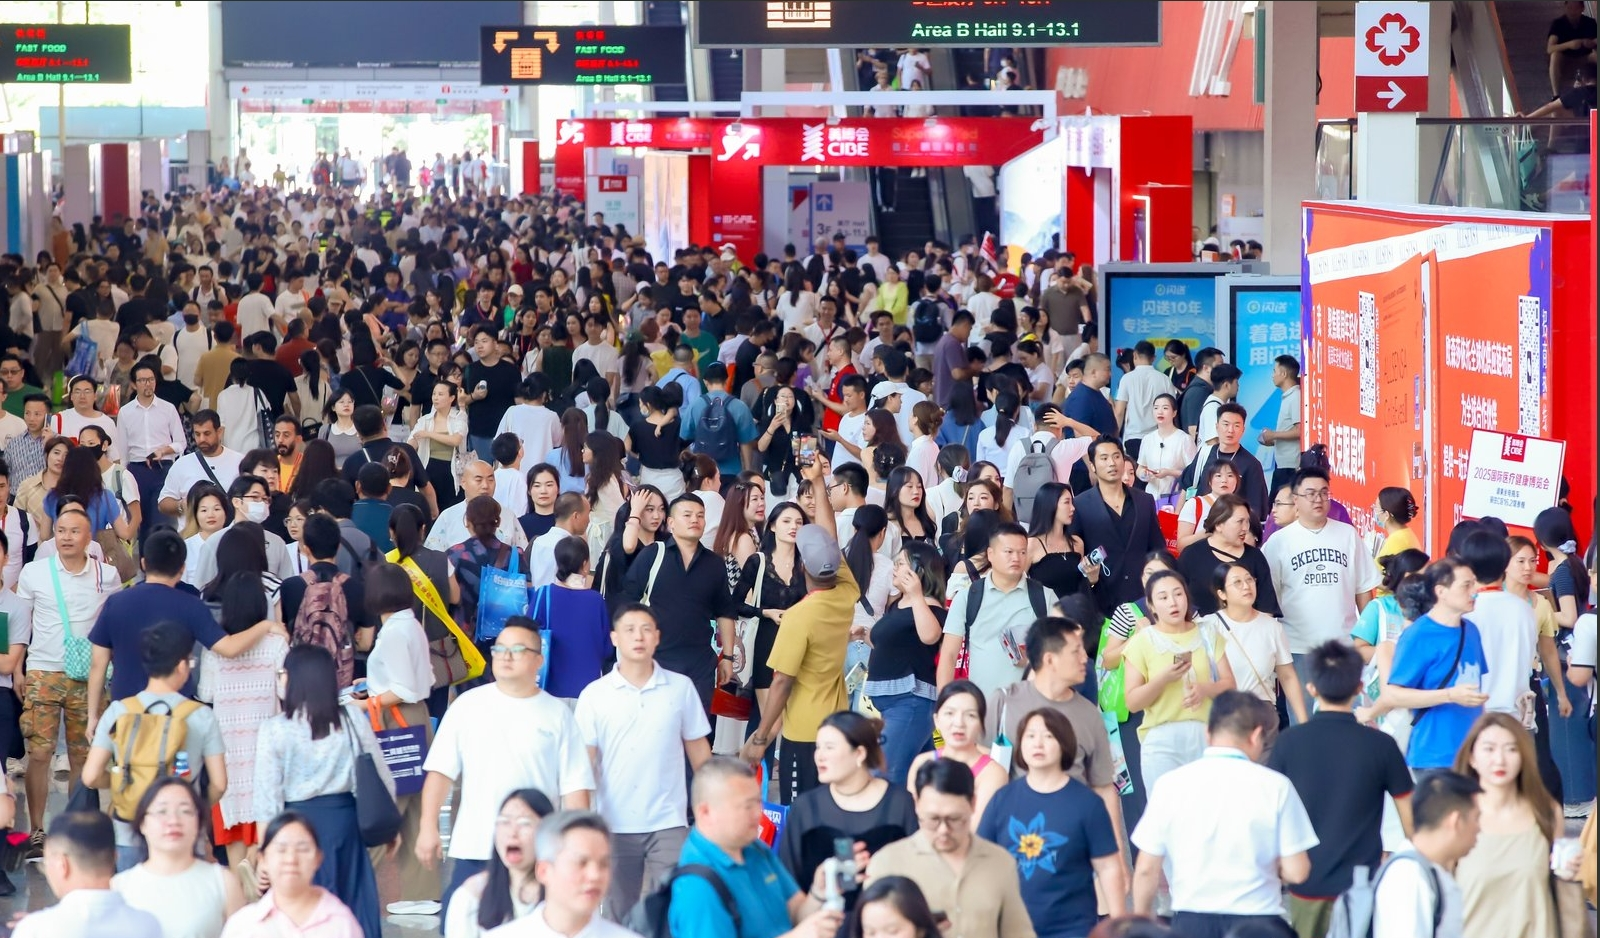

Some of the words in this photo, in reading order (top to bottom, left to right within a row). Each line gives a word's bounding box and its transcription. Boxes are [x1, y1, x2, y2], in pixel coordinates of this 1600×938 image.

[912, 23, 952, 37] Area
[957, 23, 970, 37] B
[974, 23, 1007, 37] Hall
[15, 44, 38, 53] FAST
[42, 44, 67, 53] FOOD
[575, 45, 598, 54] FAST
[600, 45, 625, 54] FOOD
[17, 73, 36, 81] Area
[37, 73, 44, 81] B
[45, 73, 62, 81] Hall
[828, 127, 870, 142] 美博会
[827, 142, 870, 157] CIBE
[1166, 284, 1187, 296] 闪送
[1142, 300, 1203, 316] 闪送10年
[1261, 301, 1288, 313] 闪送
[1473, 466, 1550, 490] 2025国际医疗健康博览会
[1290, 548, 1348, 571] SKECHERS
[1304, 572, 1339, 585] SPORTS
